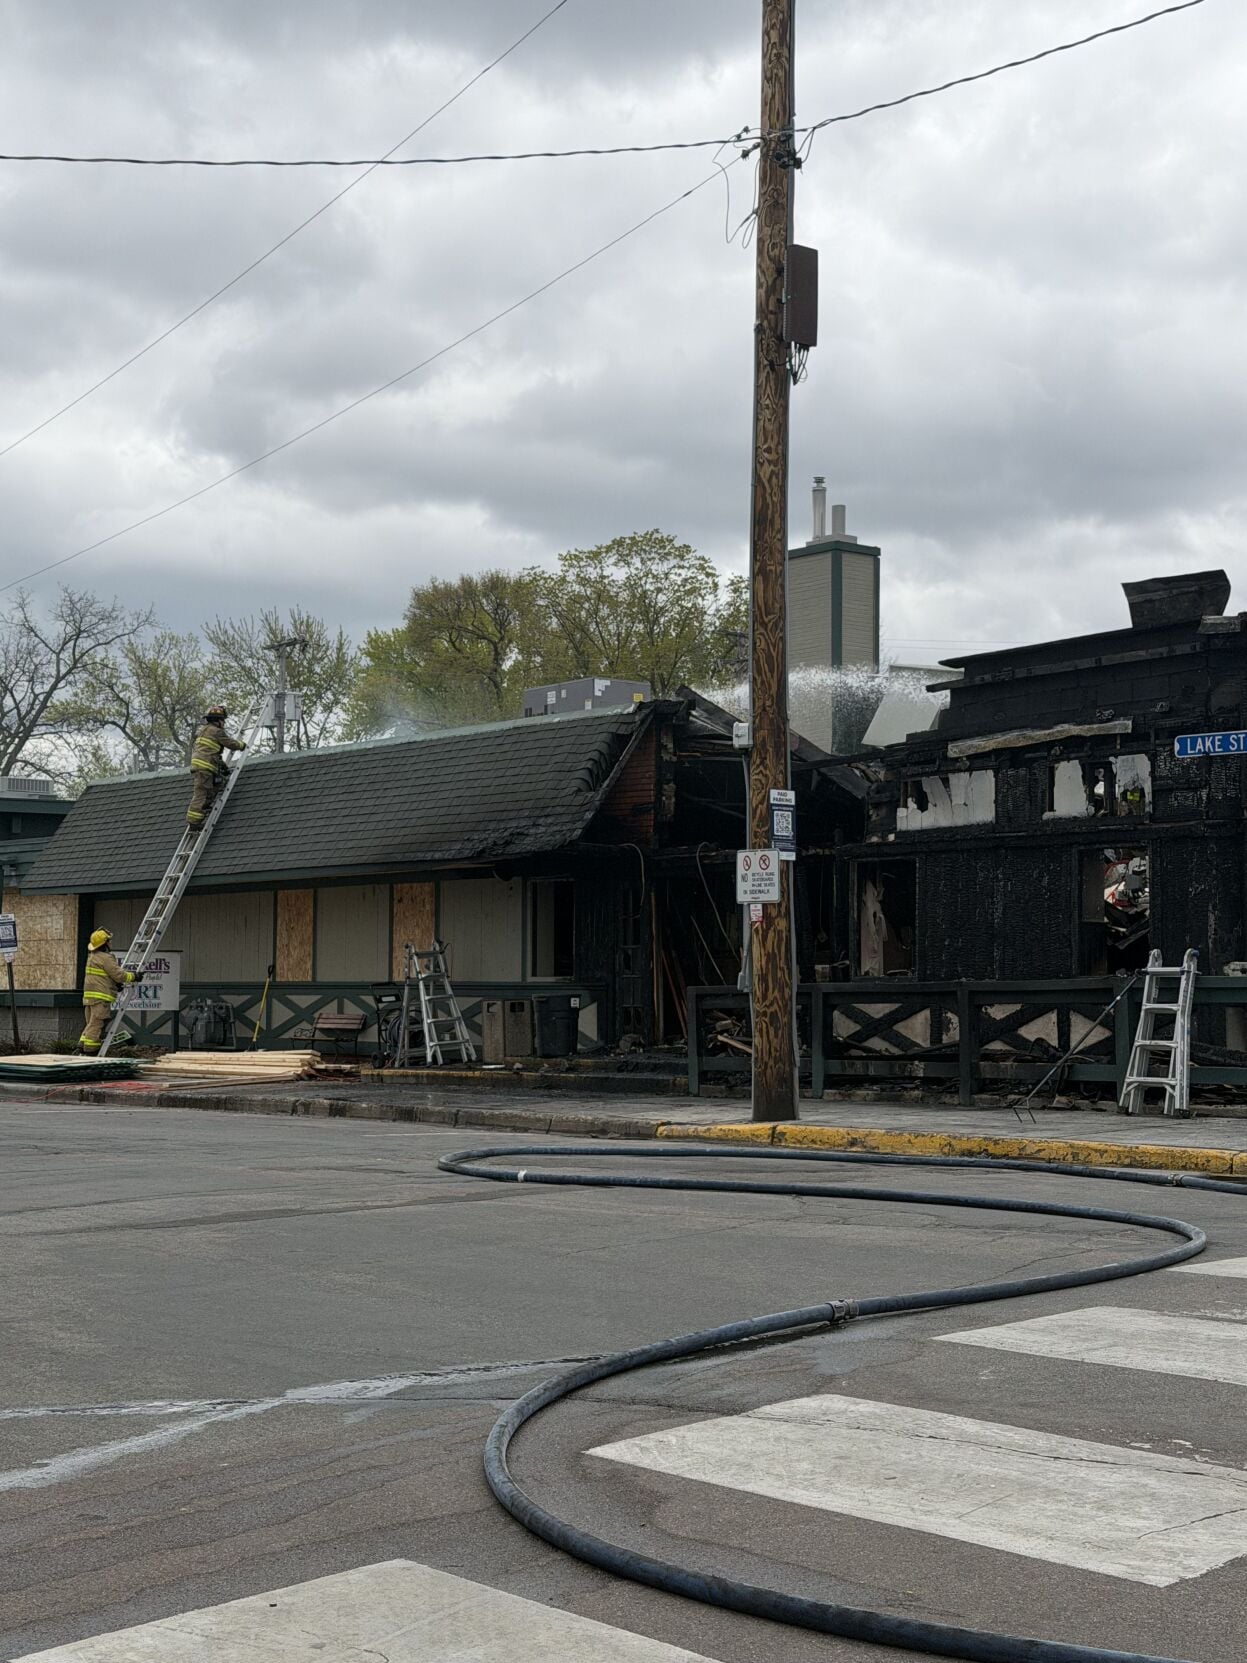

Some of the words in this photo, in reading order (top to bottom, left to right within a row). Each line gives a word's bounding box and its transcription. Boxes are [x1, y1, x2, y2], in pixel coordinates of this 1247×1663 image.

[1187, 736, 1224, 754] LAKE
[1229, 734, 1246, 751] ST
[772, 796, 793, 804] PARKING
[741, 872, 749, 883] NO
[117, 957, 170, 971] skell's
